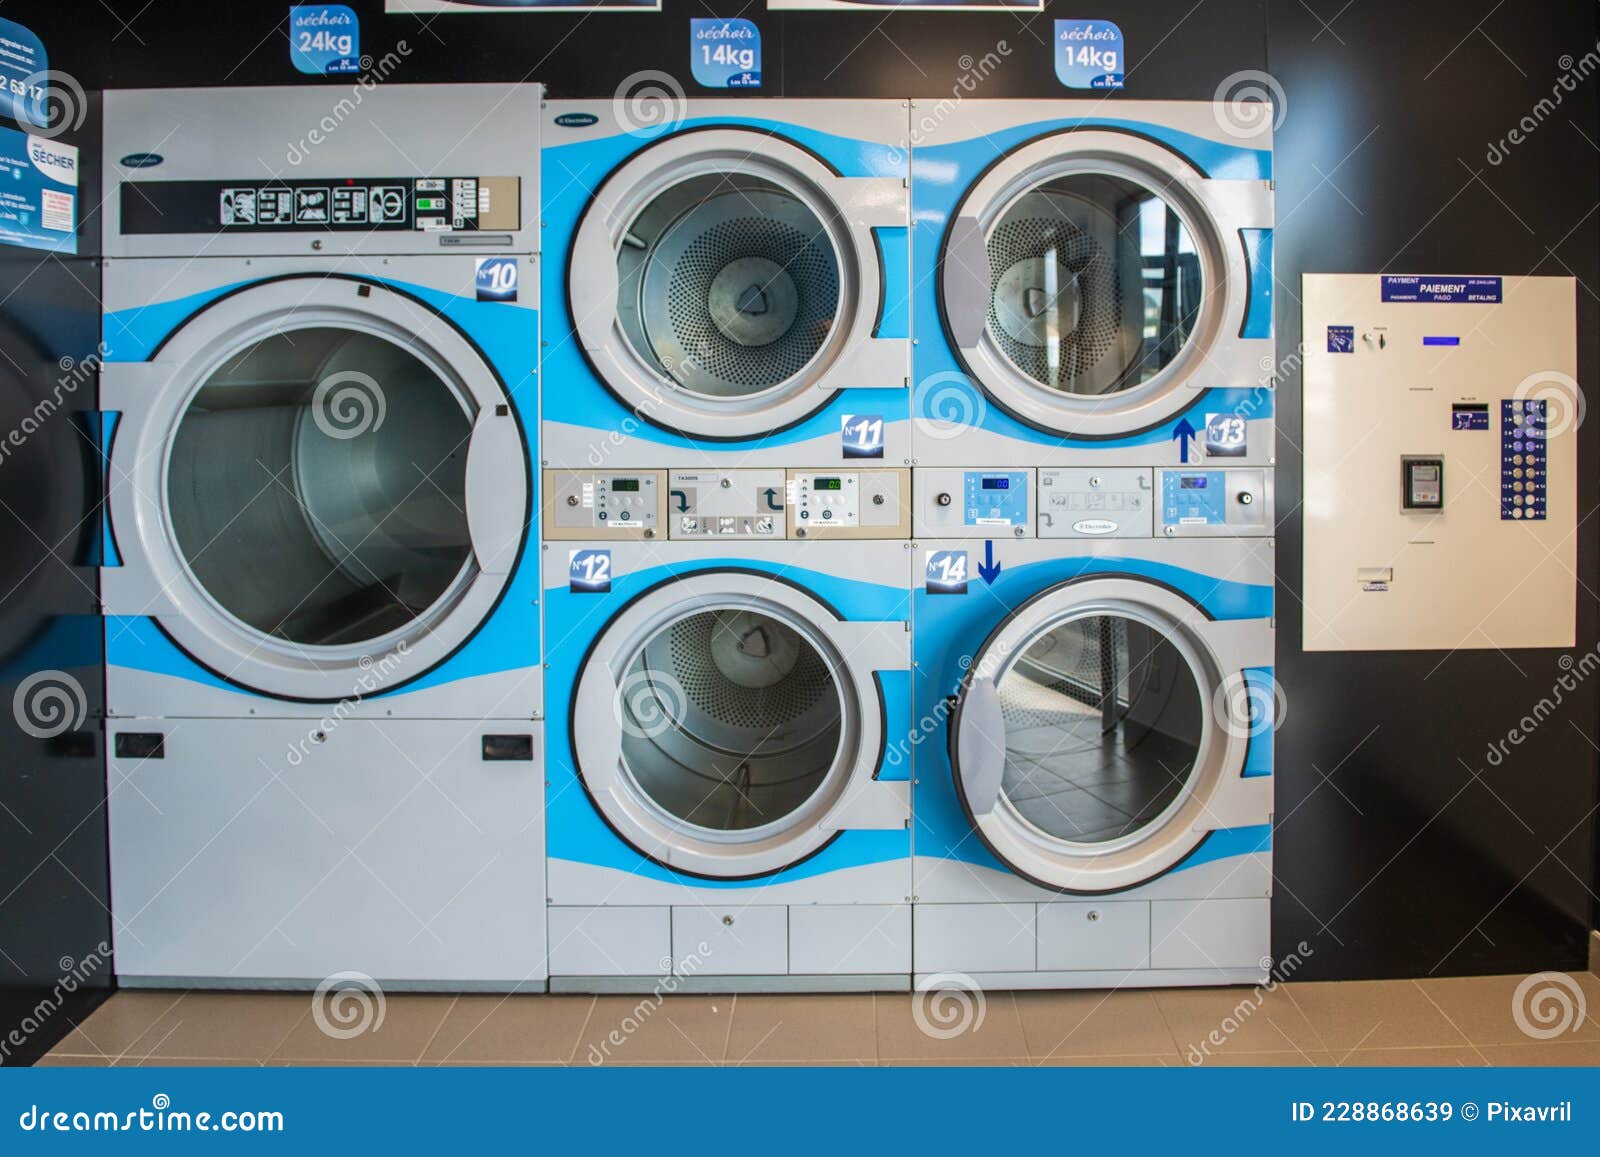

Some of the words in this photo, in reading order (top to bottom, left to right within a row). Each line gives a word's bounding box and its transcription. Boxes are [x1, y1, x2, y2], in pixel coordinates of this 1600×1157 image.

[296, 9, 351, 26] séchoir
[697, 23, 755, 39] séchoir
[1060, 25, 1118, 40] séchoir
[300, 31, 352, 55] 24kg
[702, 44, 754, 70] 14kg
[1066, 46, 1117, 72] 14kg
[10, 79, 26, 96] 63
[29, 84, 44, 101] 17
[1420, 284, 1466, 293] PAIEMENT
